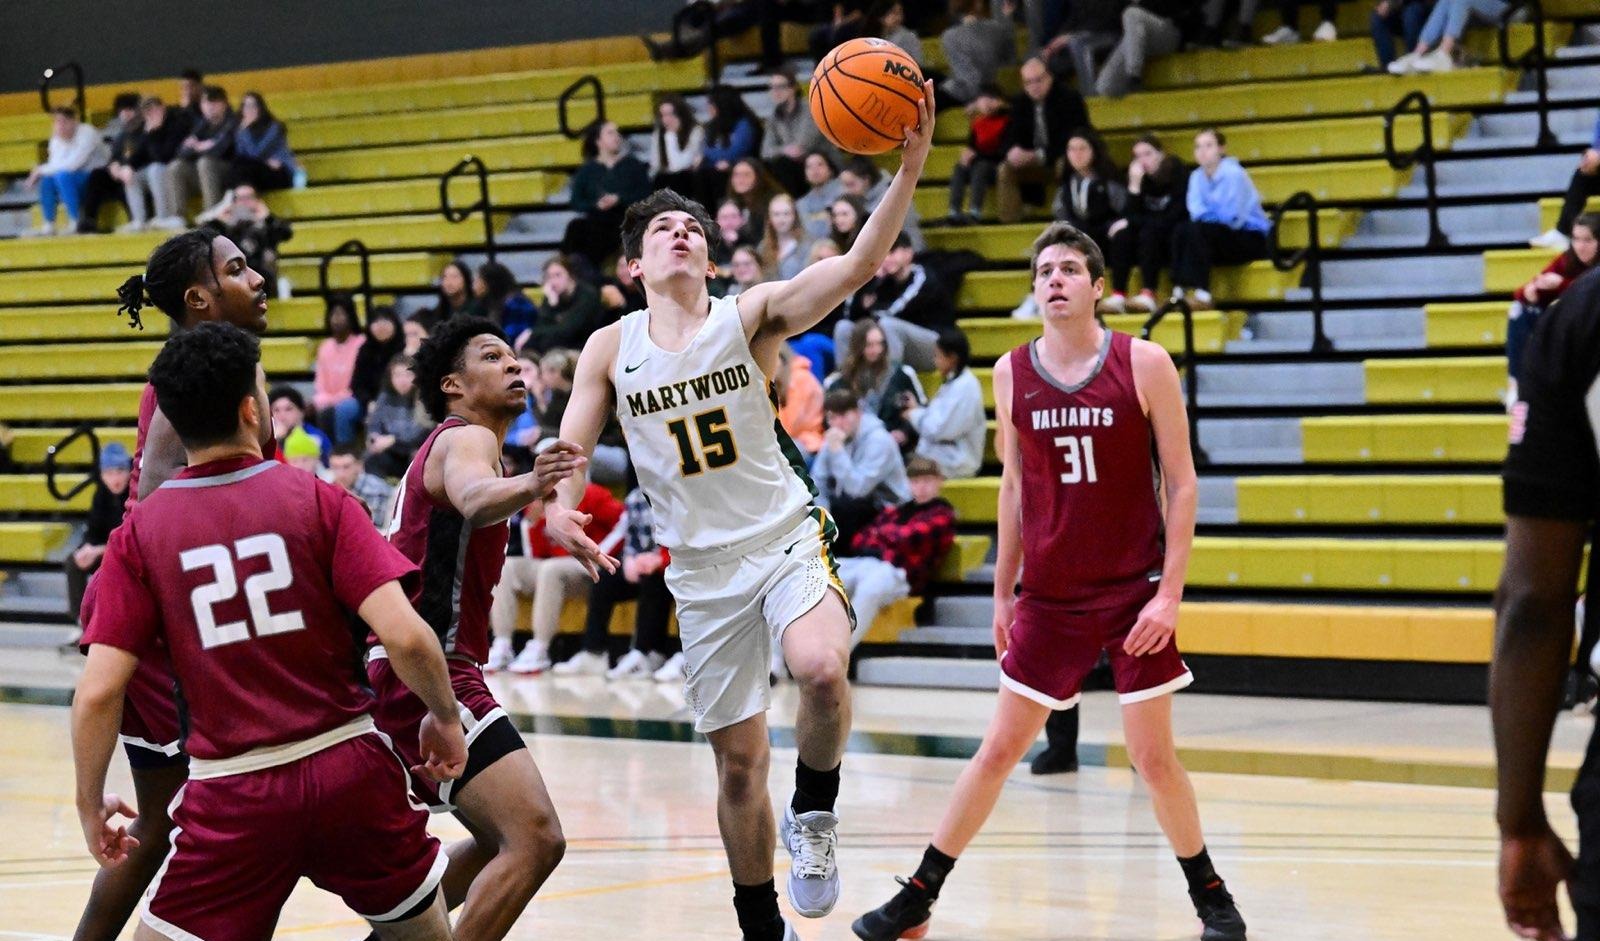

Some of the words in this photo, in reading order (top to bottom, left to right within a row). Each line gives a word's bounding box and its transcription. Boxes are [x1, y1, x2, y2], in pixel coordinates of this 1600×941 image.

[626, 363, 750, 417] MARYWOOD
[665, 405, 739, 478] 15
[1031, 406, 1114, 430] VALIANTS
[1053, 435, 1098, 484] 31
[178, 532, 307, 650] 22
